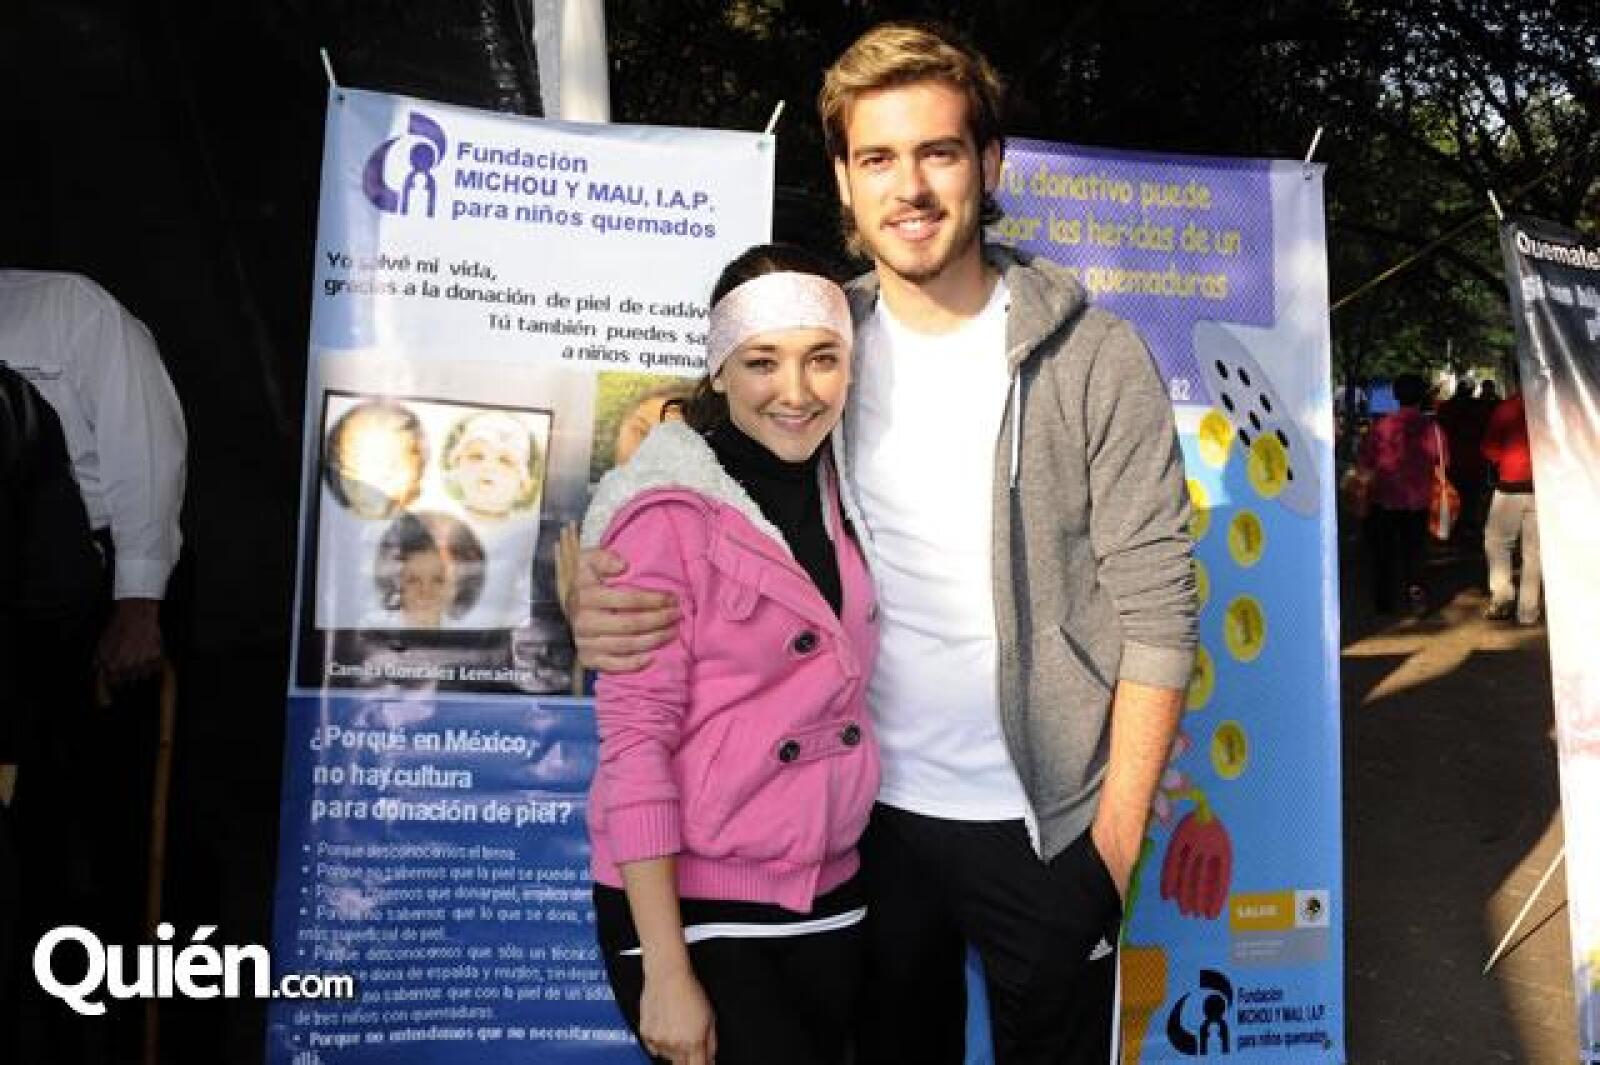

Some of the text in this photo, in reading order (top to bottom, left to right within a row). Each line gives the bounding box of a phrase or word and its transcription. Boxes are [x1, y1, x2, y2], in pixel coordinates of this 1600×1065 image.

[457, 142, 589, 173] Fundación
[454, 169, 716, 213] MICHOU Y MAU, I.A.P.
[1029, 164, 1132, 203] donativo
[1140, 181, 1211, 209] puede
[451, 199, 717, 238] para niños quemados
[327, 251, 497, 281] Yo alvé mi vida,
[405, 282, 416, 296] a
[422, 279, 440, 298] la
[445, 282, 536, 306] donación
[546, 291, 570, 309] de
[576, 294, 611, 313] piel
[619, 296, 643, 314] de
[489, 314, 510, 332] Tú
[517, 316, 596, 337] también
[607, 325, 678, 342] puedes
[562, 346, 573, 360] a
[578, 344, 631, 363] niños
[310, 726, 534, 759] ¿Porqué en México,
[313, 763, 473, 790] no hay cultura
[310, 798, 572, 827] para donación de piel?
